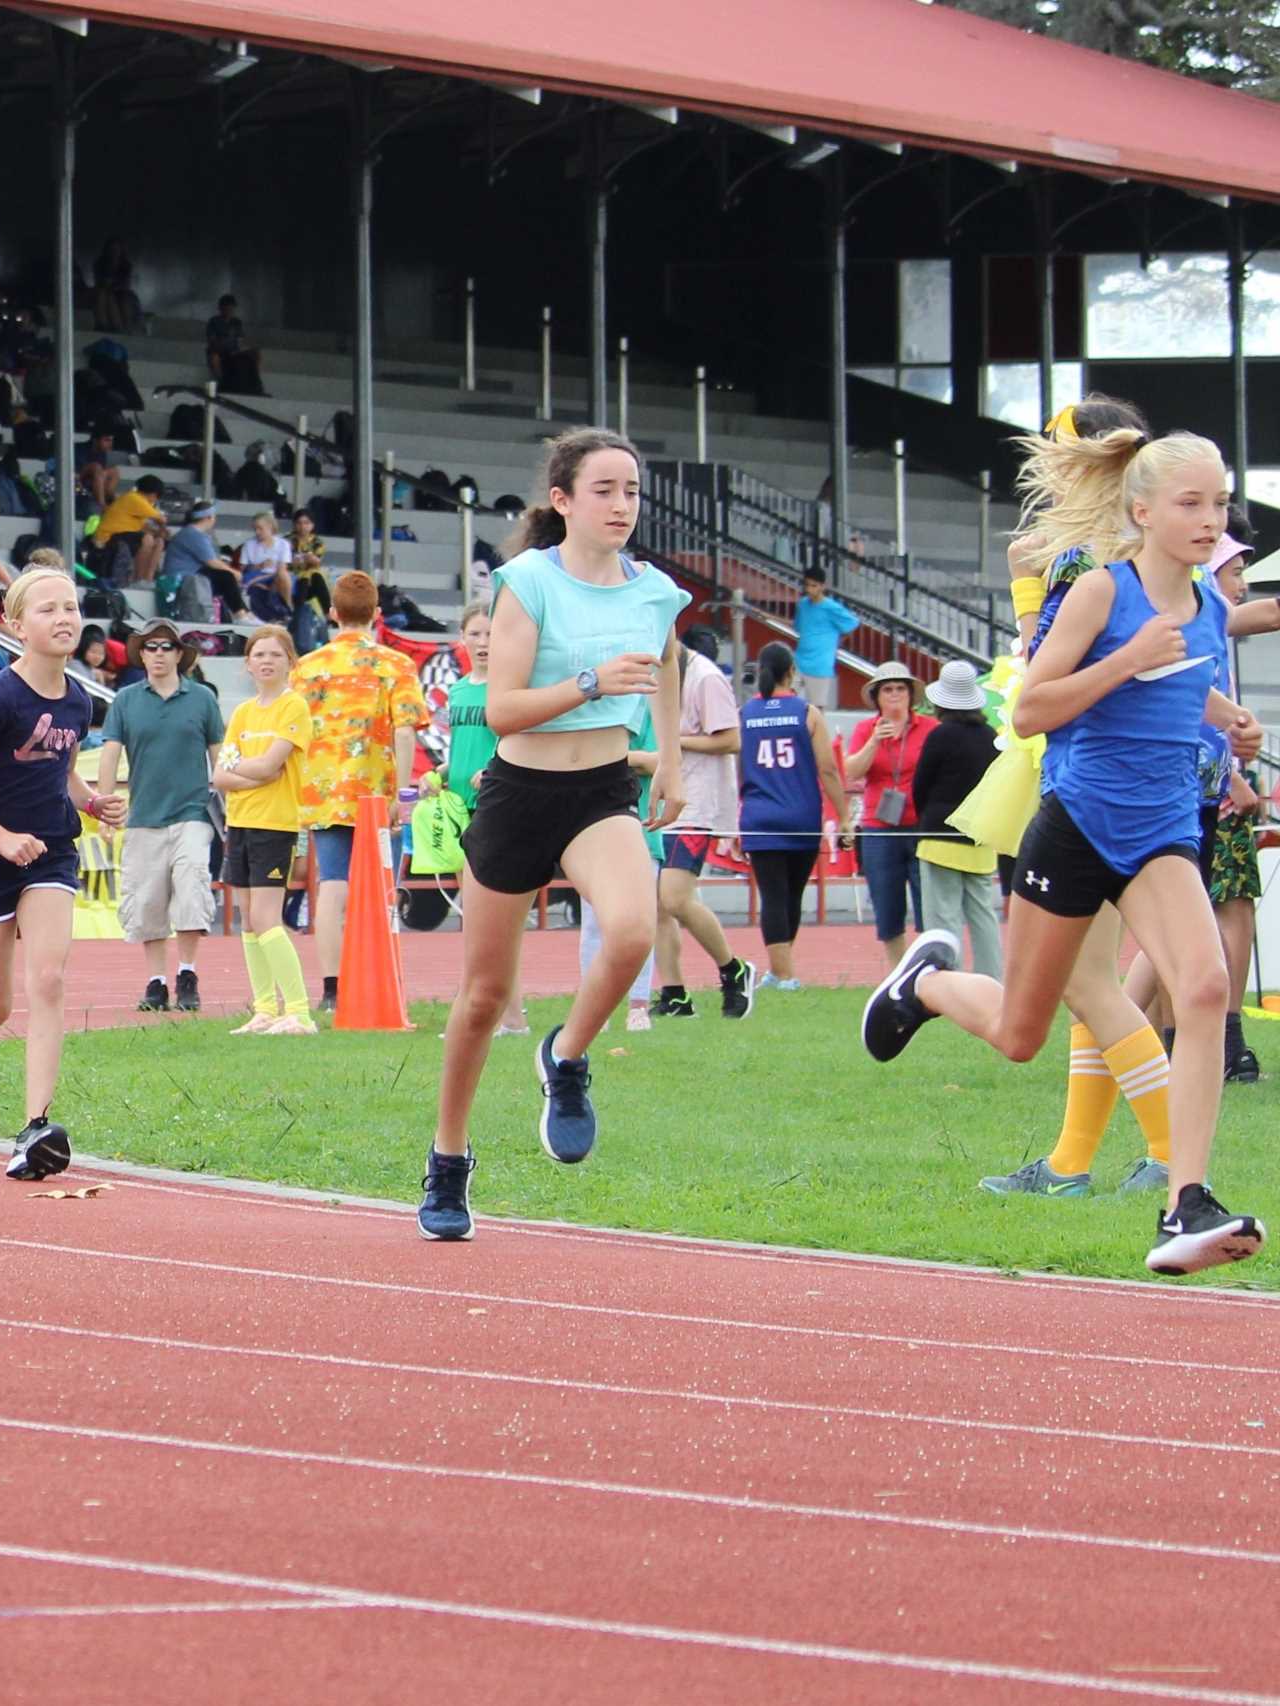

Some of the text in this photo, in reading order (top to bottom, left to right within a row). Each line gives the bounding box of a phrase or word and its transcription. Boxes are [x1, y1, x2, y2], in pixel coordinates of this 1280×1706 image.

[746, 716, 800, 729] FUNCTIONAL
[757, 738, 797, 769] 45
[432, 824, 444, 852] NIKE
